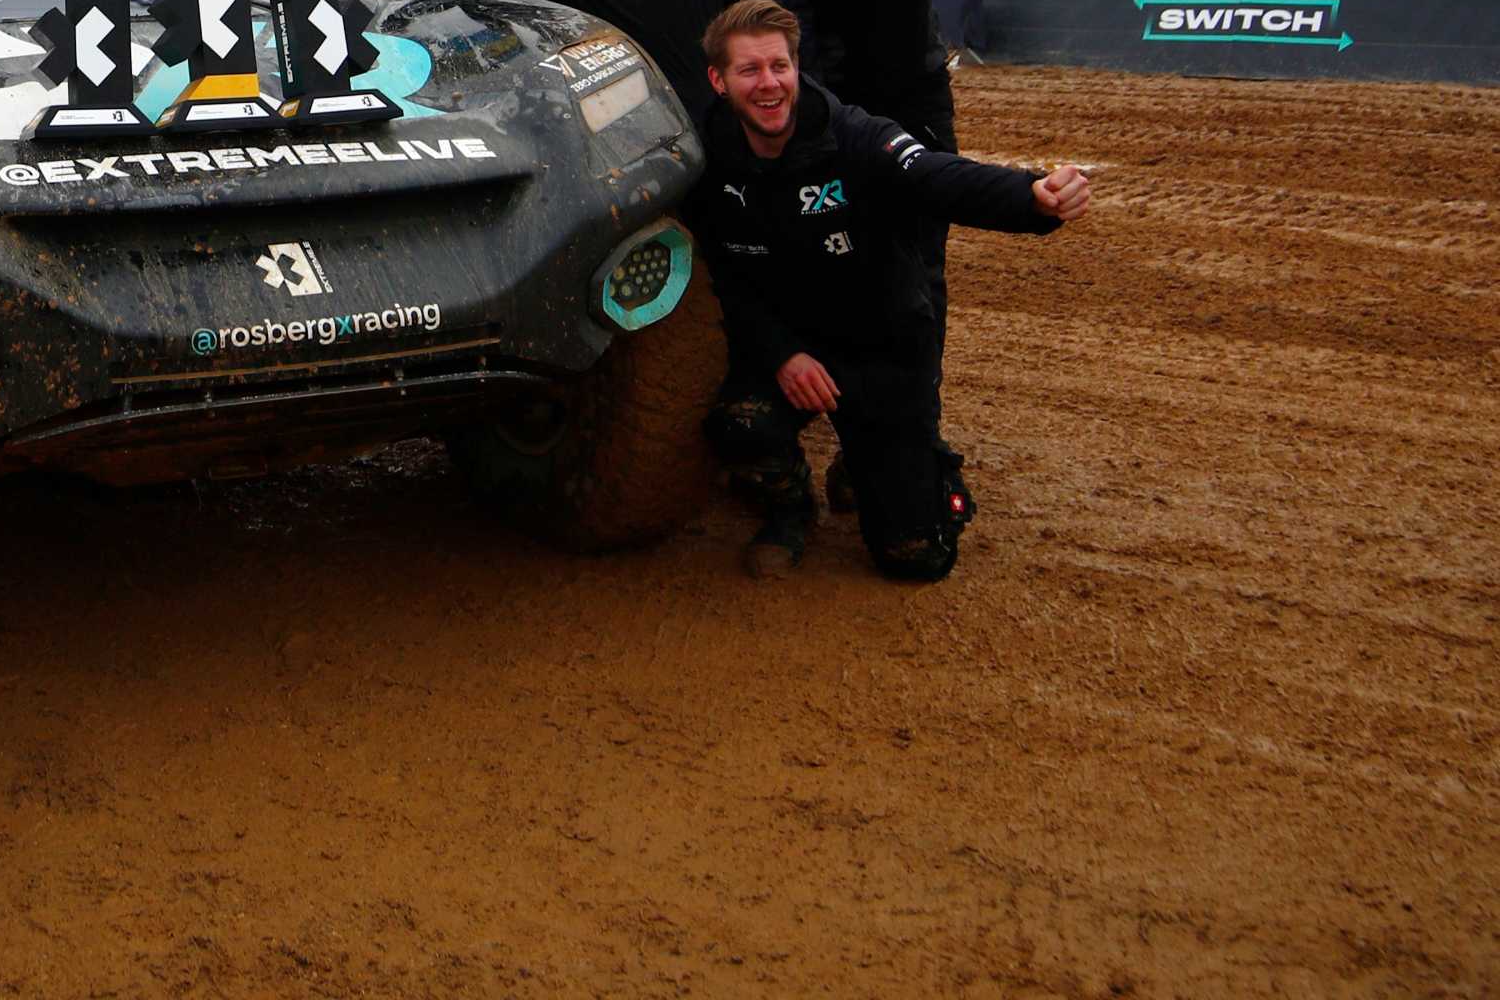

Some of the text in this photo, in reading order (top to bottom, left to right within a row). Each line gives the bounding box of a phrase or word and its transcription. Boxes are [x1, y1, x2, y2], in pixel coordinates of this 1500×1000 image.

[1158, 8, 1324, 33] SWITCH
[0, 137, 497, 186] @EXTREMEELIVE
[191, 303, 441, 356] @rosbergxracing
